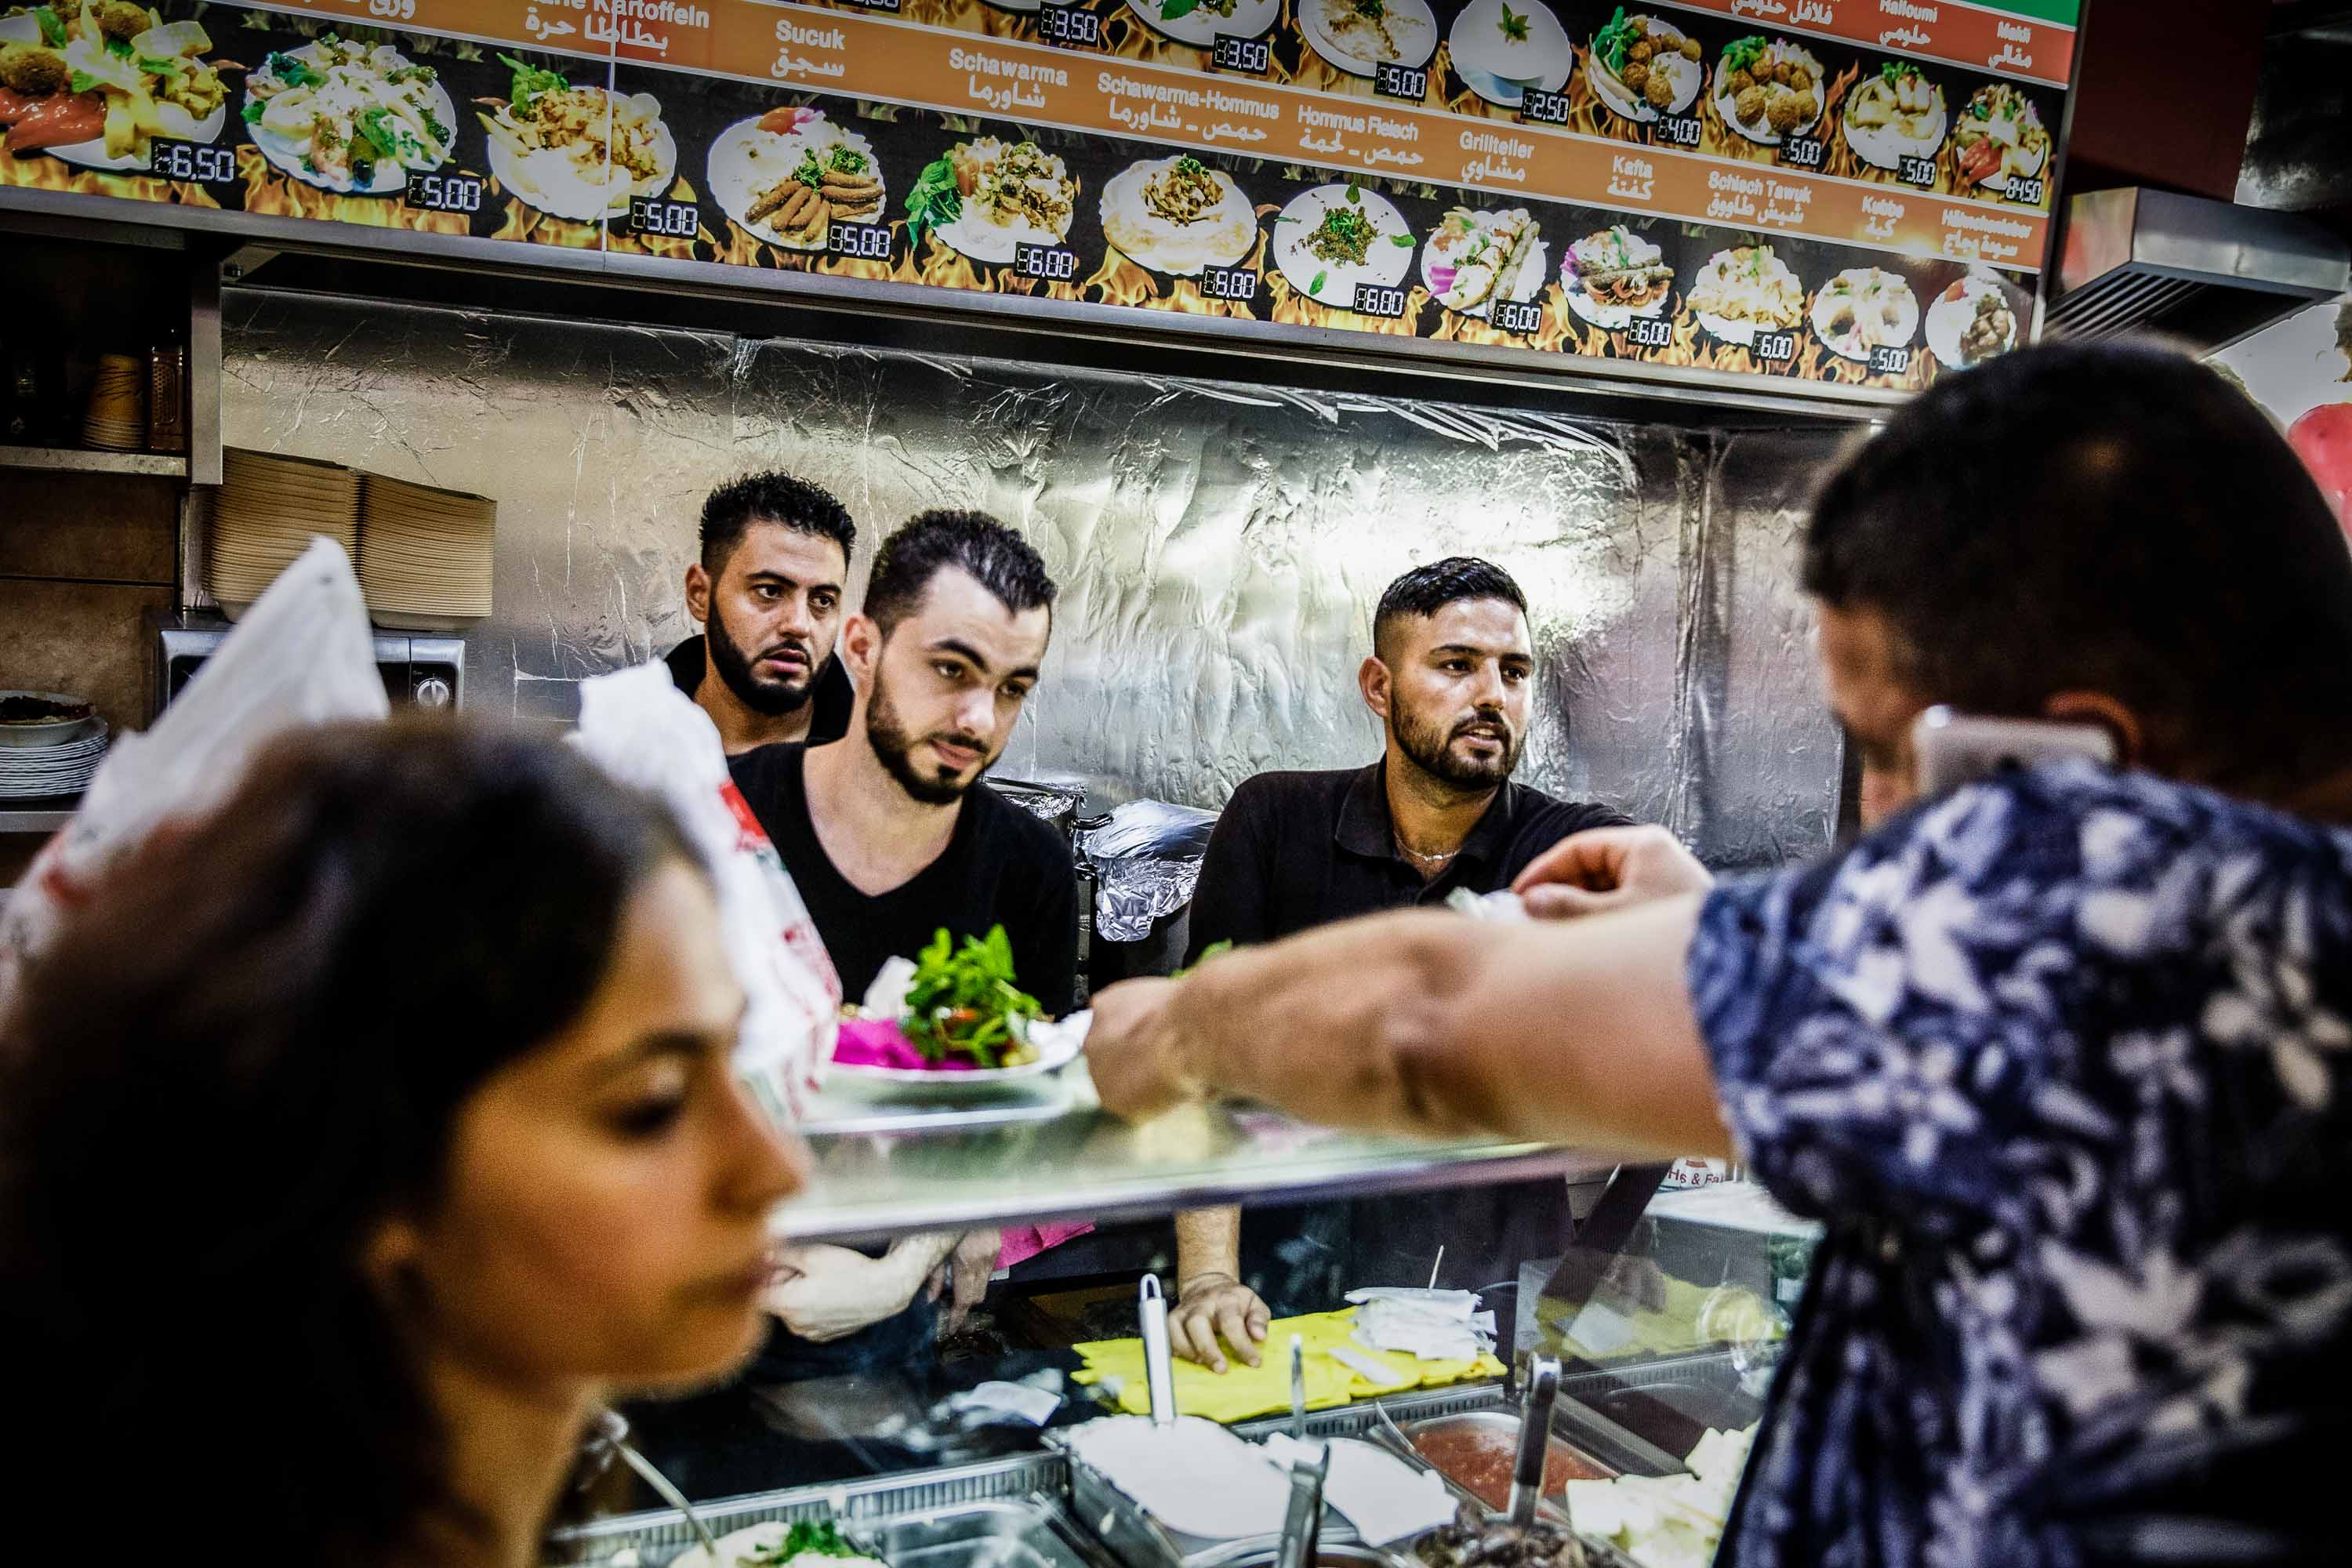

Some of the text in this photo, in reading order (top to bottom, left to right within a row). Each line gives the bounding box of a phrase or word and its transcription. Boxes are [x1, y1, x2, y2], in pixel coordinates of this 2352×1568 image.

[593, 0, 710, 28] Kartoffeln
[525, 6, 669, 58] بطاطا حرة
[775, 19, 846, 51] Sucuk
[1879, 24, 1932, 47] حلومي
[771, 48, 845, 78] سجق
[949, 48, 1069, 86] Schawarma
[968, 75, 1046, 111] شاورما
[1098, 71, 1280, 120] Schawarma-Hommus
[1109, 96, 1182, 131] شاورما
[1298, 103, 1419, 142] Hommus Fleisch
[1202, 121, 1268, 141] حمص
[1459, 130, 1535, 160] Grillteller
[1363, 144, 1425, 165] حمص
[1461, 155, 1526, 183] مشاوي
[1612, 154, 1653, 179] Kafta
[1607, 176, 1656, 201] كفتة
[1756, 198, 1804, 226] شيش
